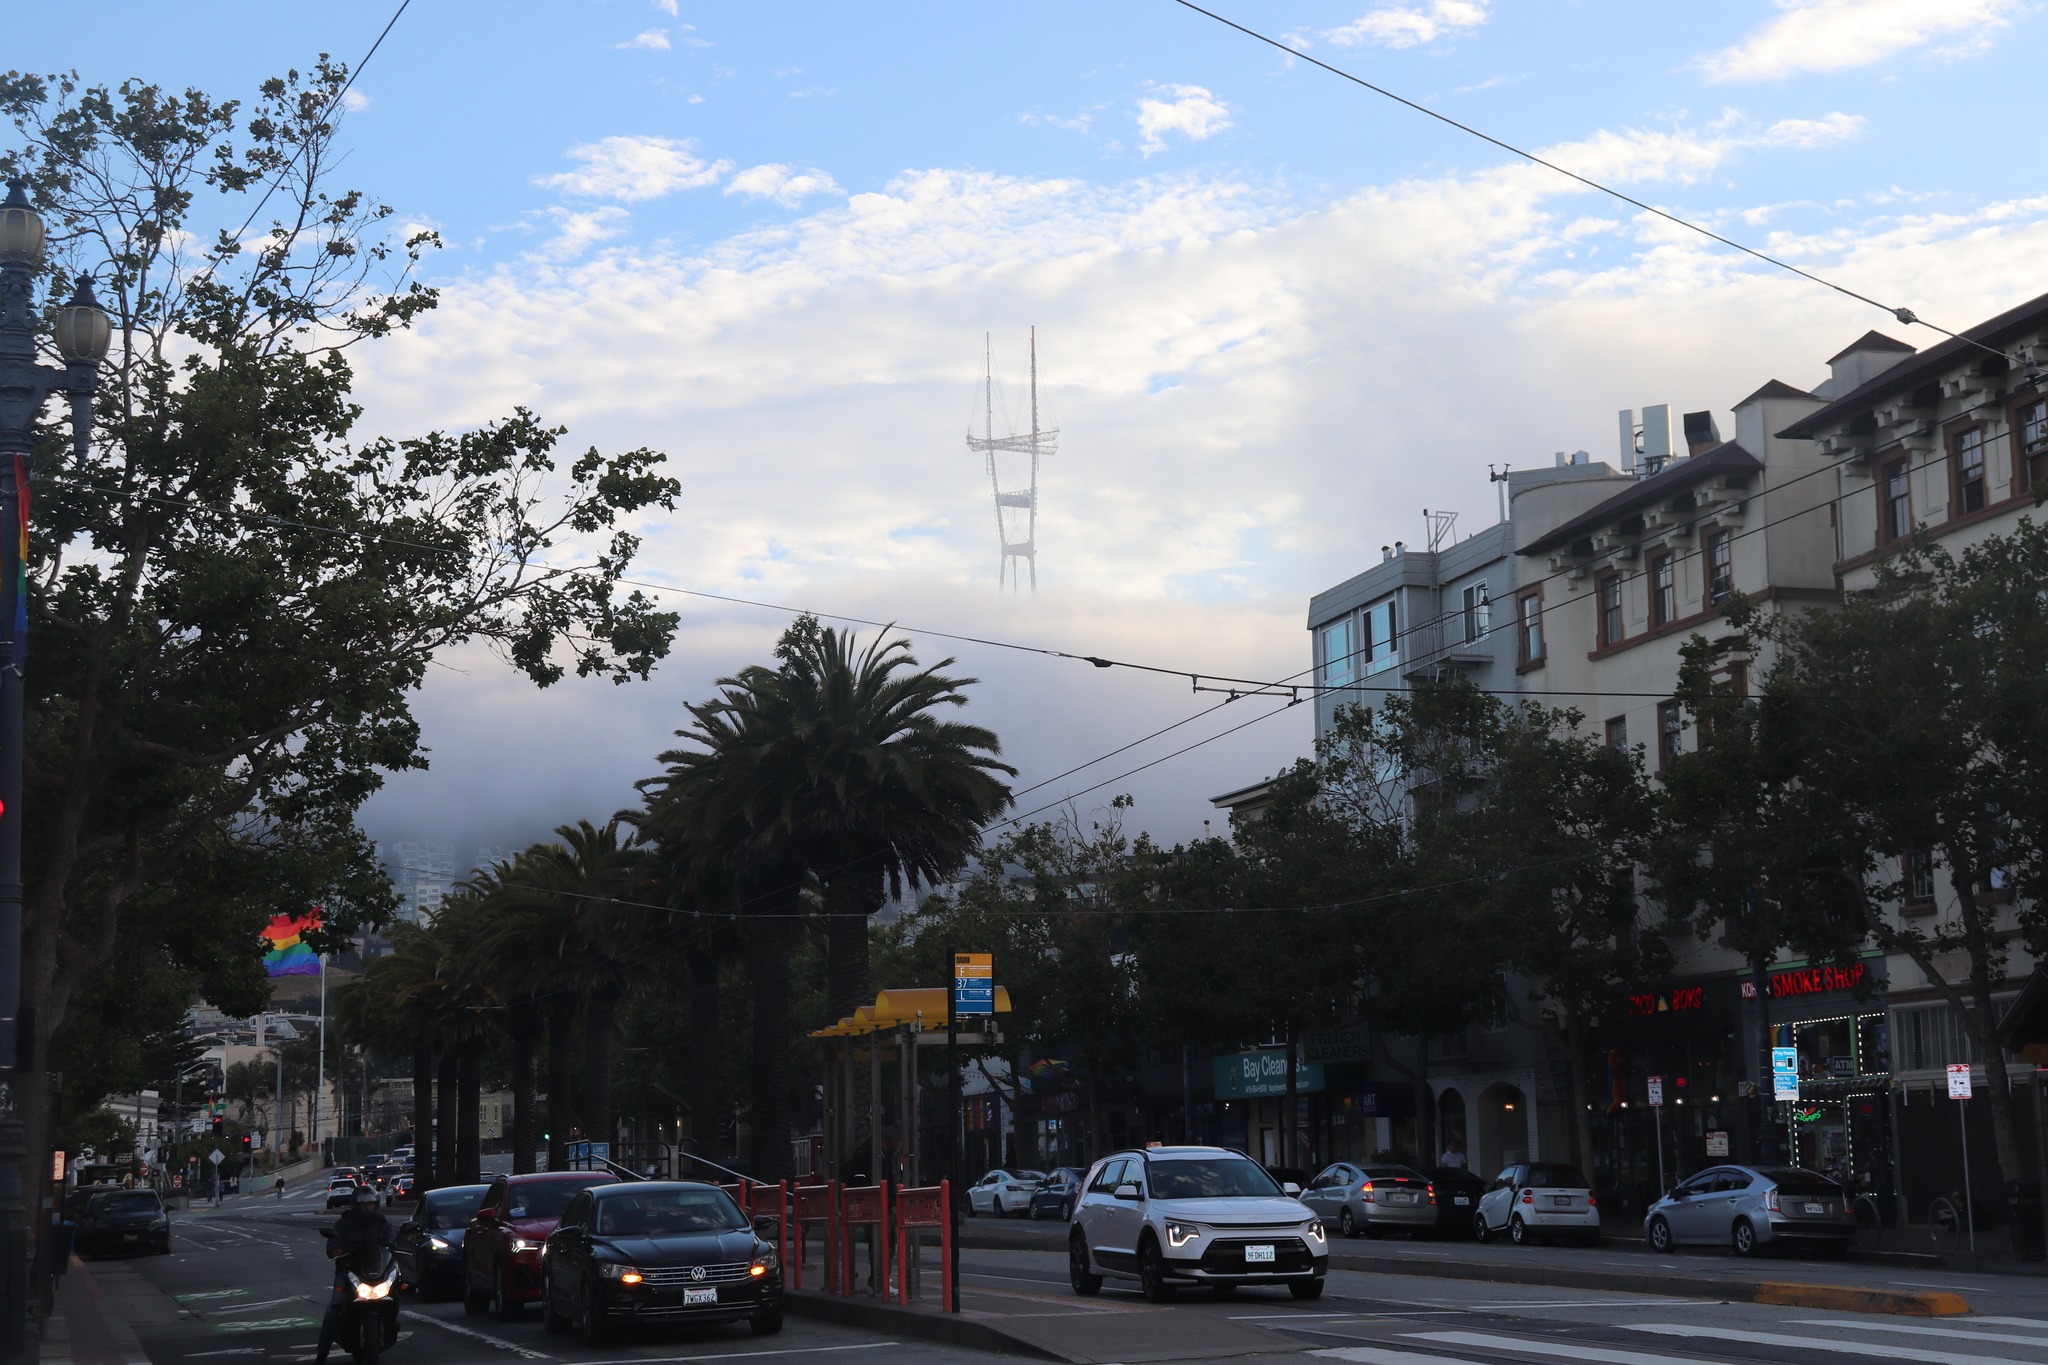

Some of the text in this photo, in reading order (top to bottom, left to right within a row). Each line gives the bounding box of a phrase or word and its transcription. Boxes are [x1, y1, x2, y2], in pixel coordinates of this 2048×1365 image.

[960, 967, 965, 977] F
[957, 979, 968, 989] 37
[1773, 969, 1822, 997] SMOKE
[1824, 963, 1865, 991] SHOP
[960, 990, 965, 1000] L
[1672, 986, 1702, 1011] BOYS
[1311, 1031, 1361, 1045] FRENCH
[1307, 1045, 1368, 1060] CLEANERS
[1243, 1055, 1301, 1082] Bay Cleans
[1835, 1060, 1853, 1070] ATM
[1363, 1093, 1376, 1106] ART
[1796, 1109, 1822, 1122] CIGARS
